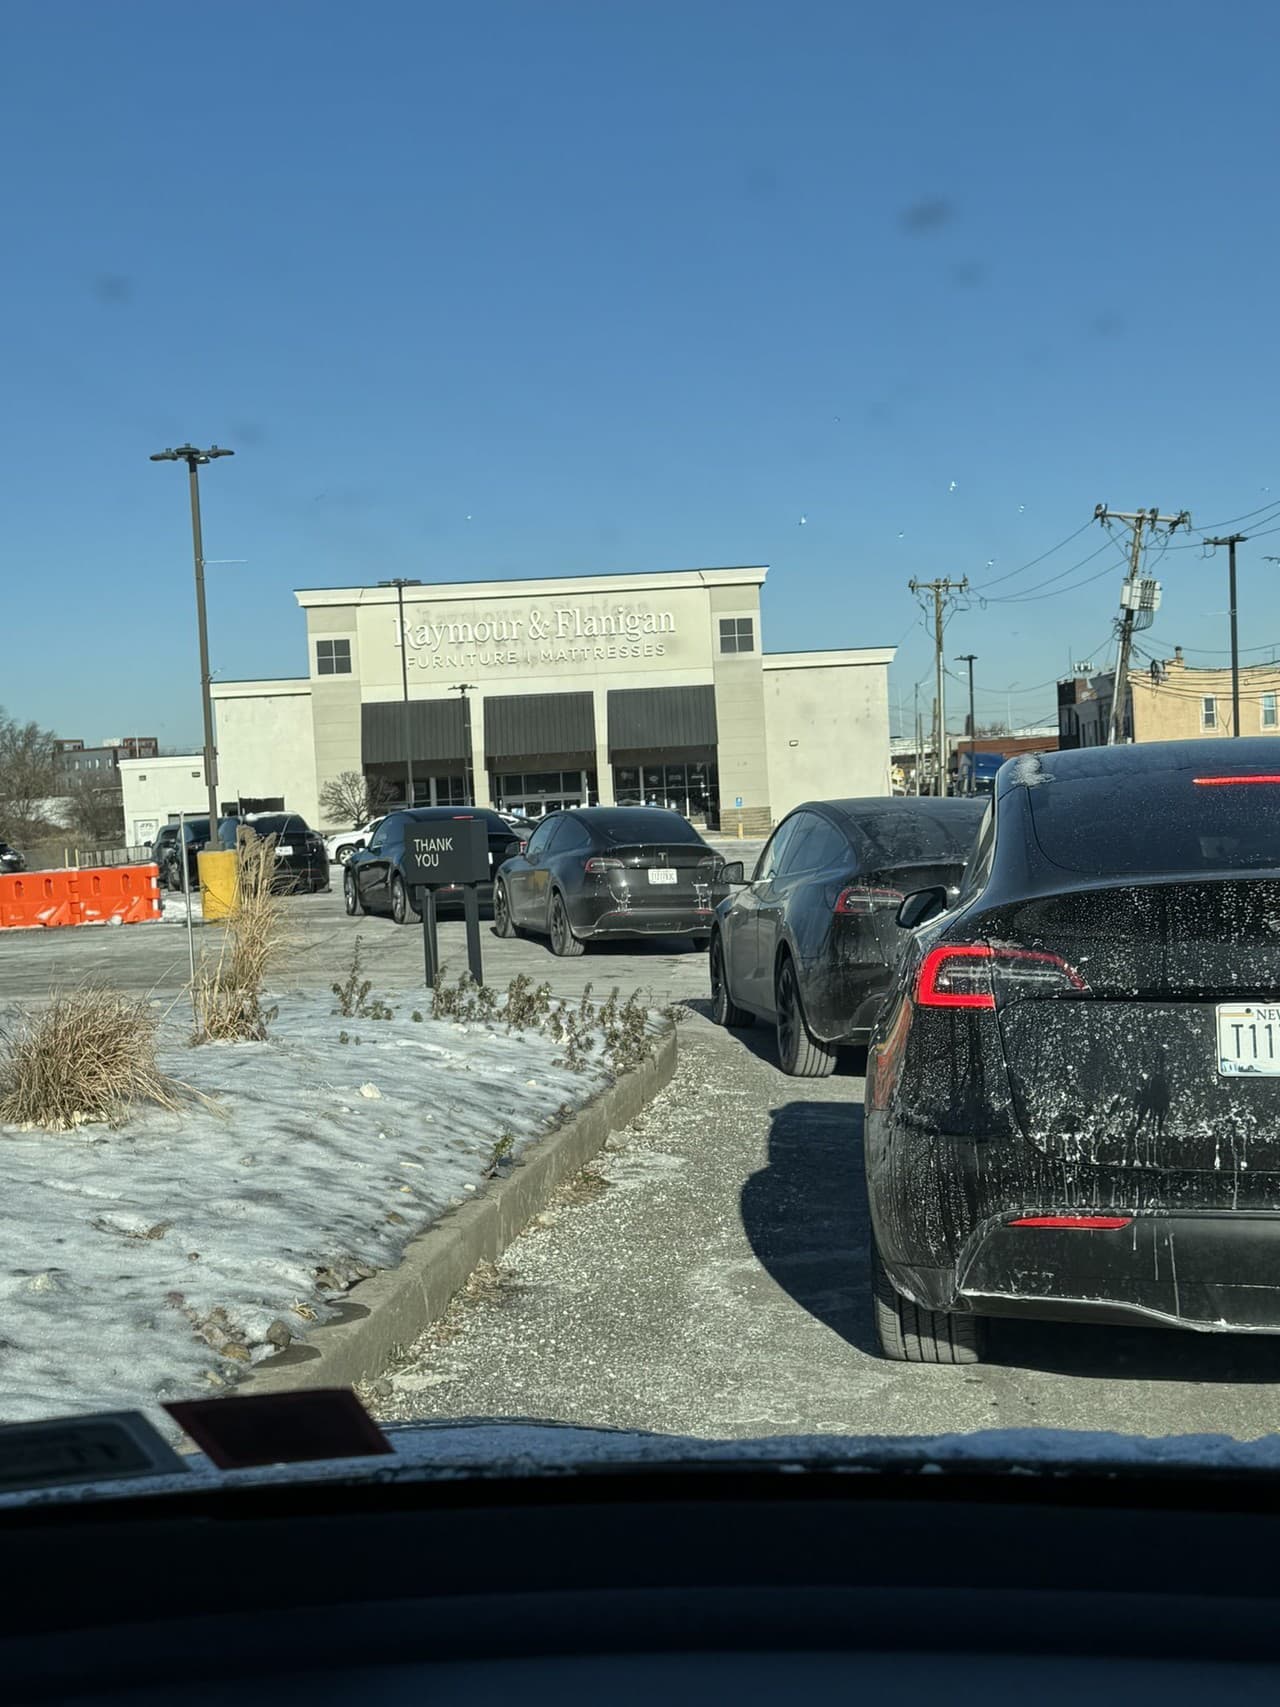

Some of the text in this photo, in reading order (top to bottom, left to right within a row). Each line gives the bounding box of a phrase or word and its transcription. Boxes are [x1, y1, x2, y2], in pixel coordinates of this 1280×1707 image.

[393, 607, 676, 651] Raymour & Flanigan
[407, 651, 518, 670] FURNITURE
[540, 644, 666, 663] MATTRESSES
[413, 838, 453, 851] THANK
[414, 853, 439, 867] YOU
[1231, 1023, 1280, 1058] T11
